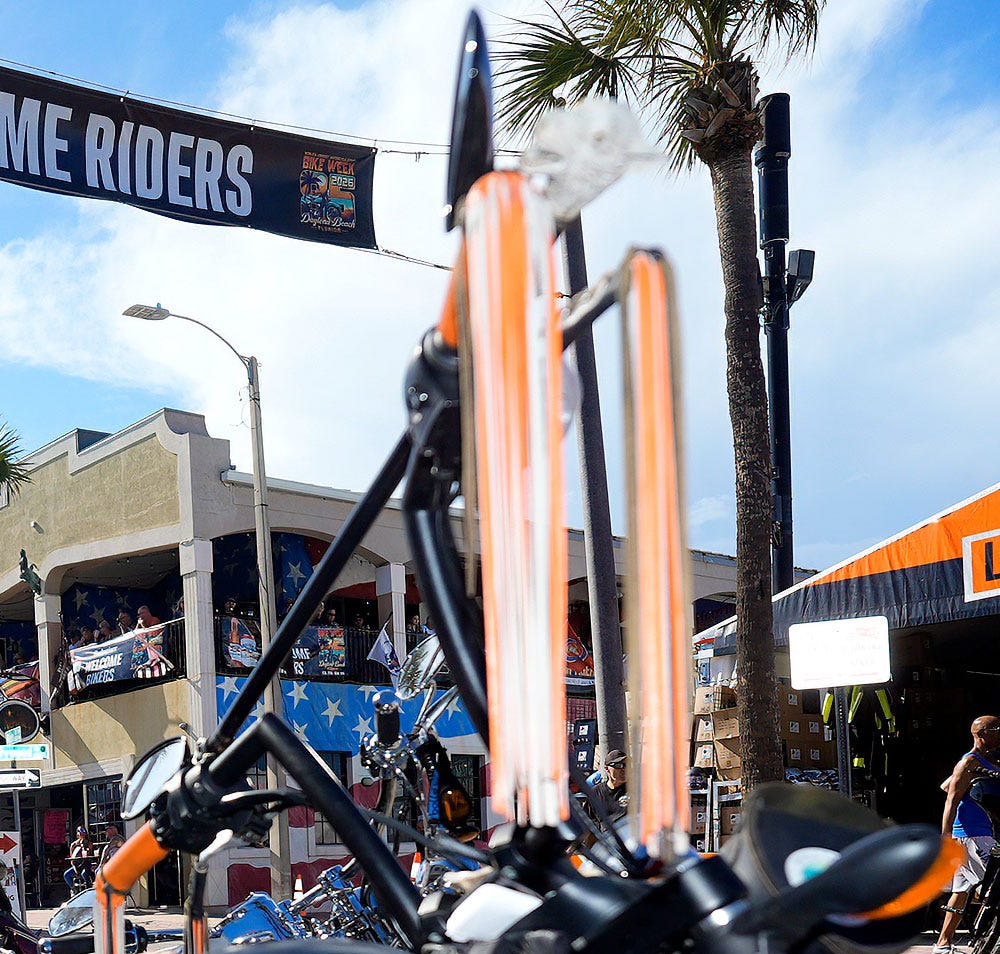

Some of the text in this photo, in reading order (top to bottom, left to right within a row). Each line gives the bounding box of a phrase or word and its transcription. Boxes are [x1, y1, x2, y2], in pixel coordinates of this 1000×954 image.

[85, 113, 255, 217] RIDERS
[303, 156, 325, 171] BIKE
[328, 160, 355, 175] WEEK
[332, 176, 354, 187] 2026
[301, 213, 355, 228] Daytona Beach
[83, 653, 124, 673] WELCOME
[86, 668, 115, 686] BIKERS
